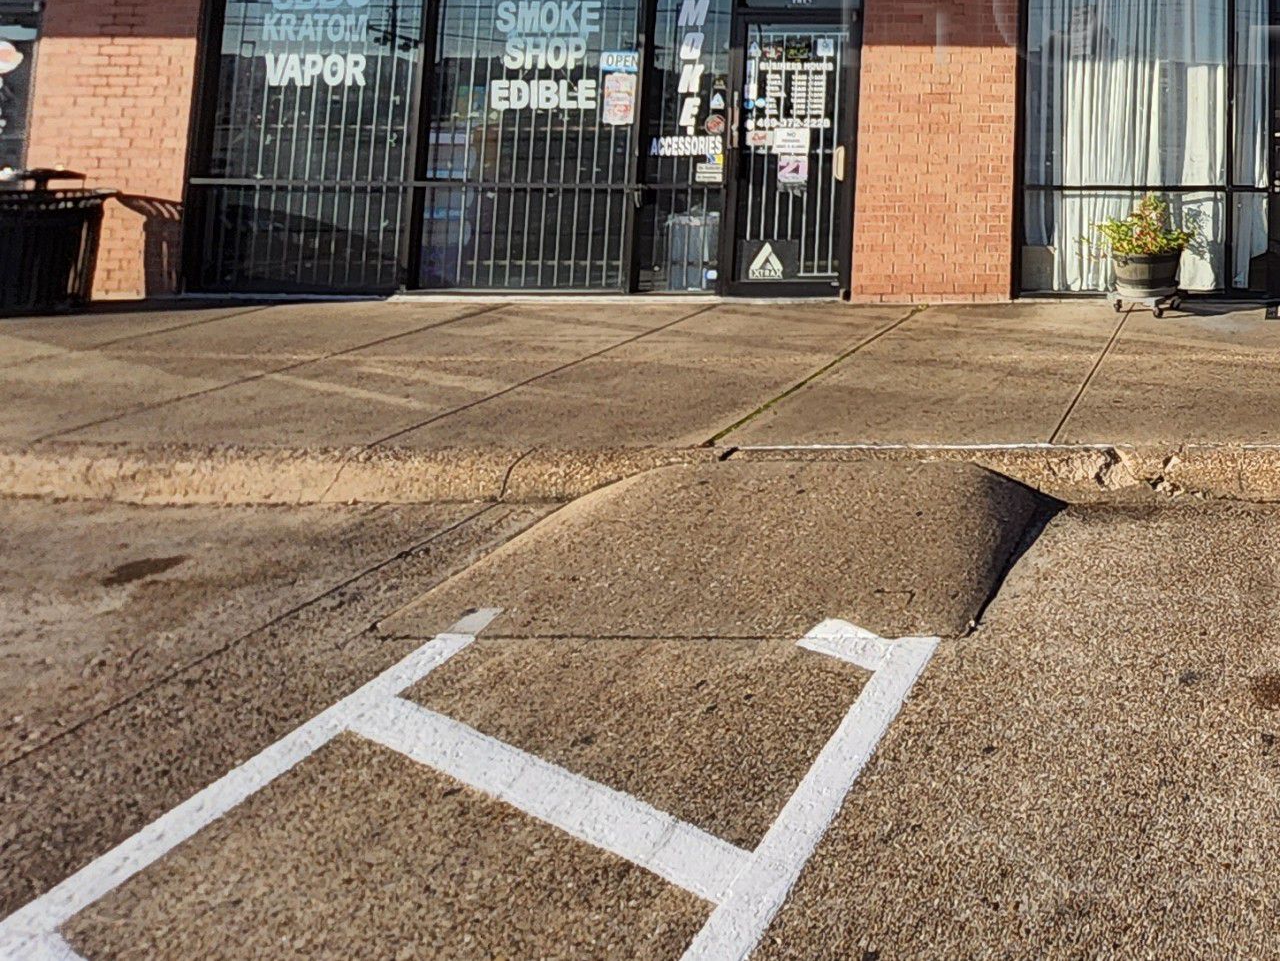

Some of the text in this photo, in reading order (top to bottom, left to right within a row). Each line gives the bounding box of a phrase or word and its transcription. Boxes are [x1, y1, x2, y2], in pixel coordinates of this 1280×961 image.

[261, 13, 370, 41] KRATOM
[496, 0, 602, 33] SMOKE
[503, 36, 588, 70] SHOP
[264, 53, 368, 87] VAPOR
[490, 79, 597, 110] EDIBLE
[650, 135, 723, 157] ACCESSORIES
